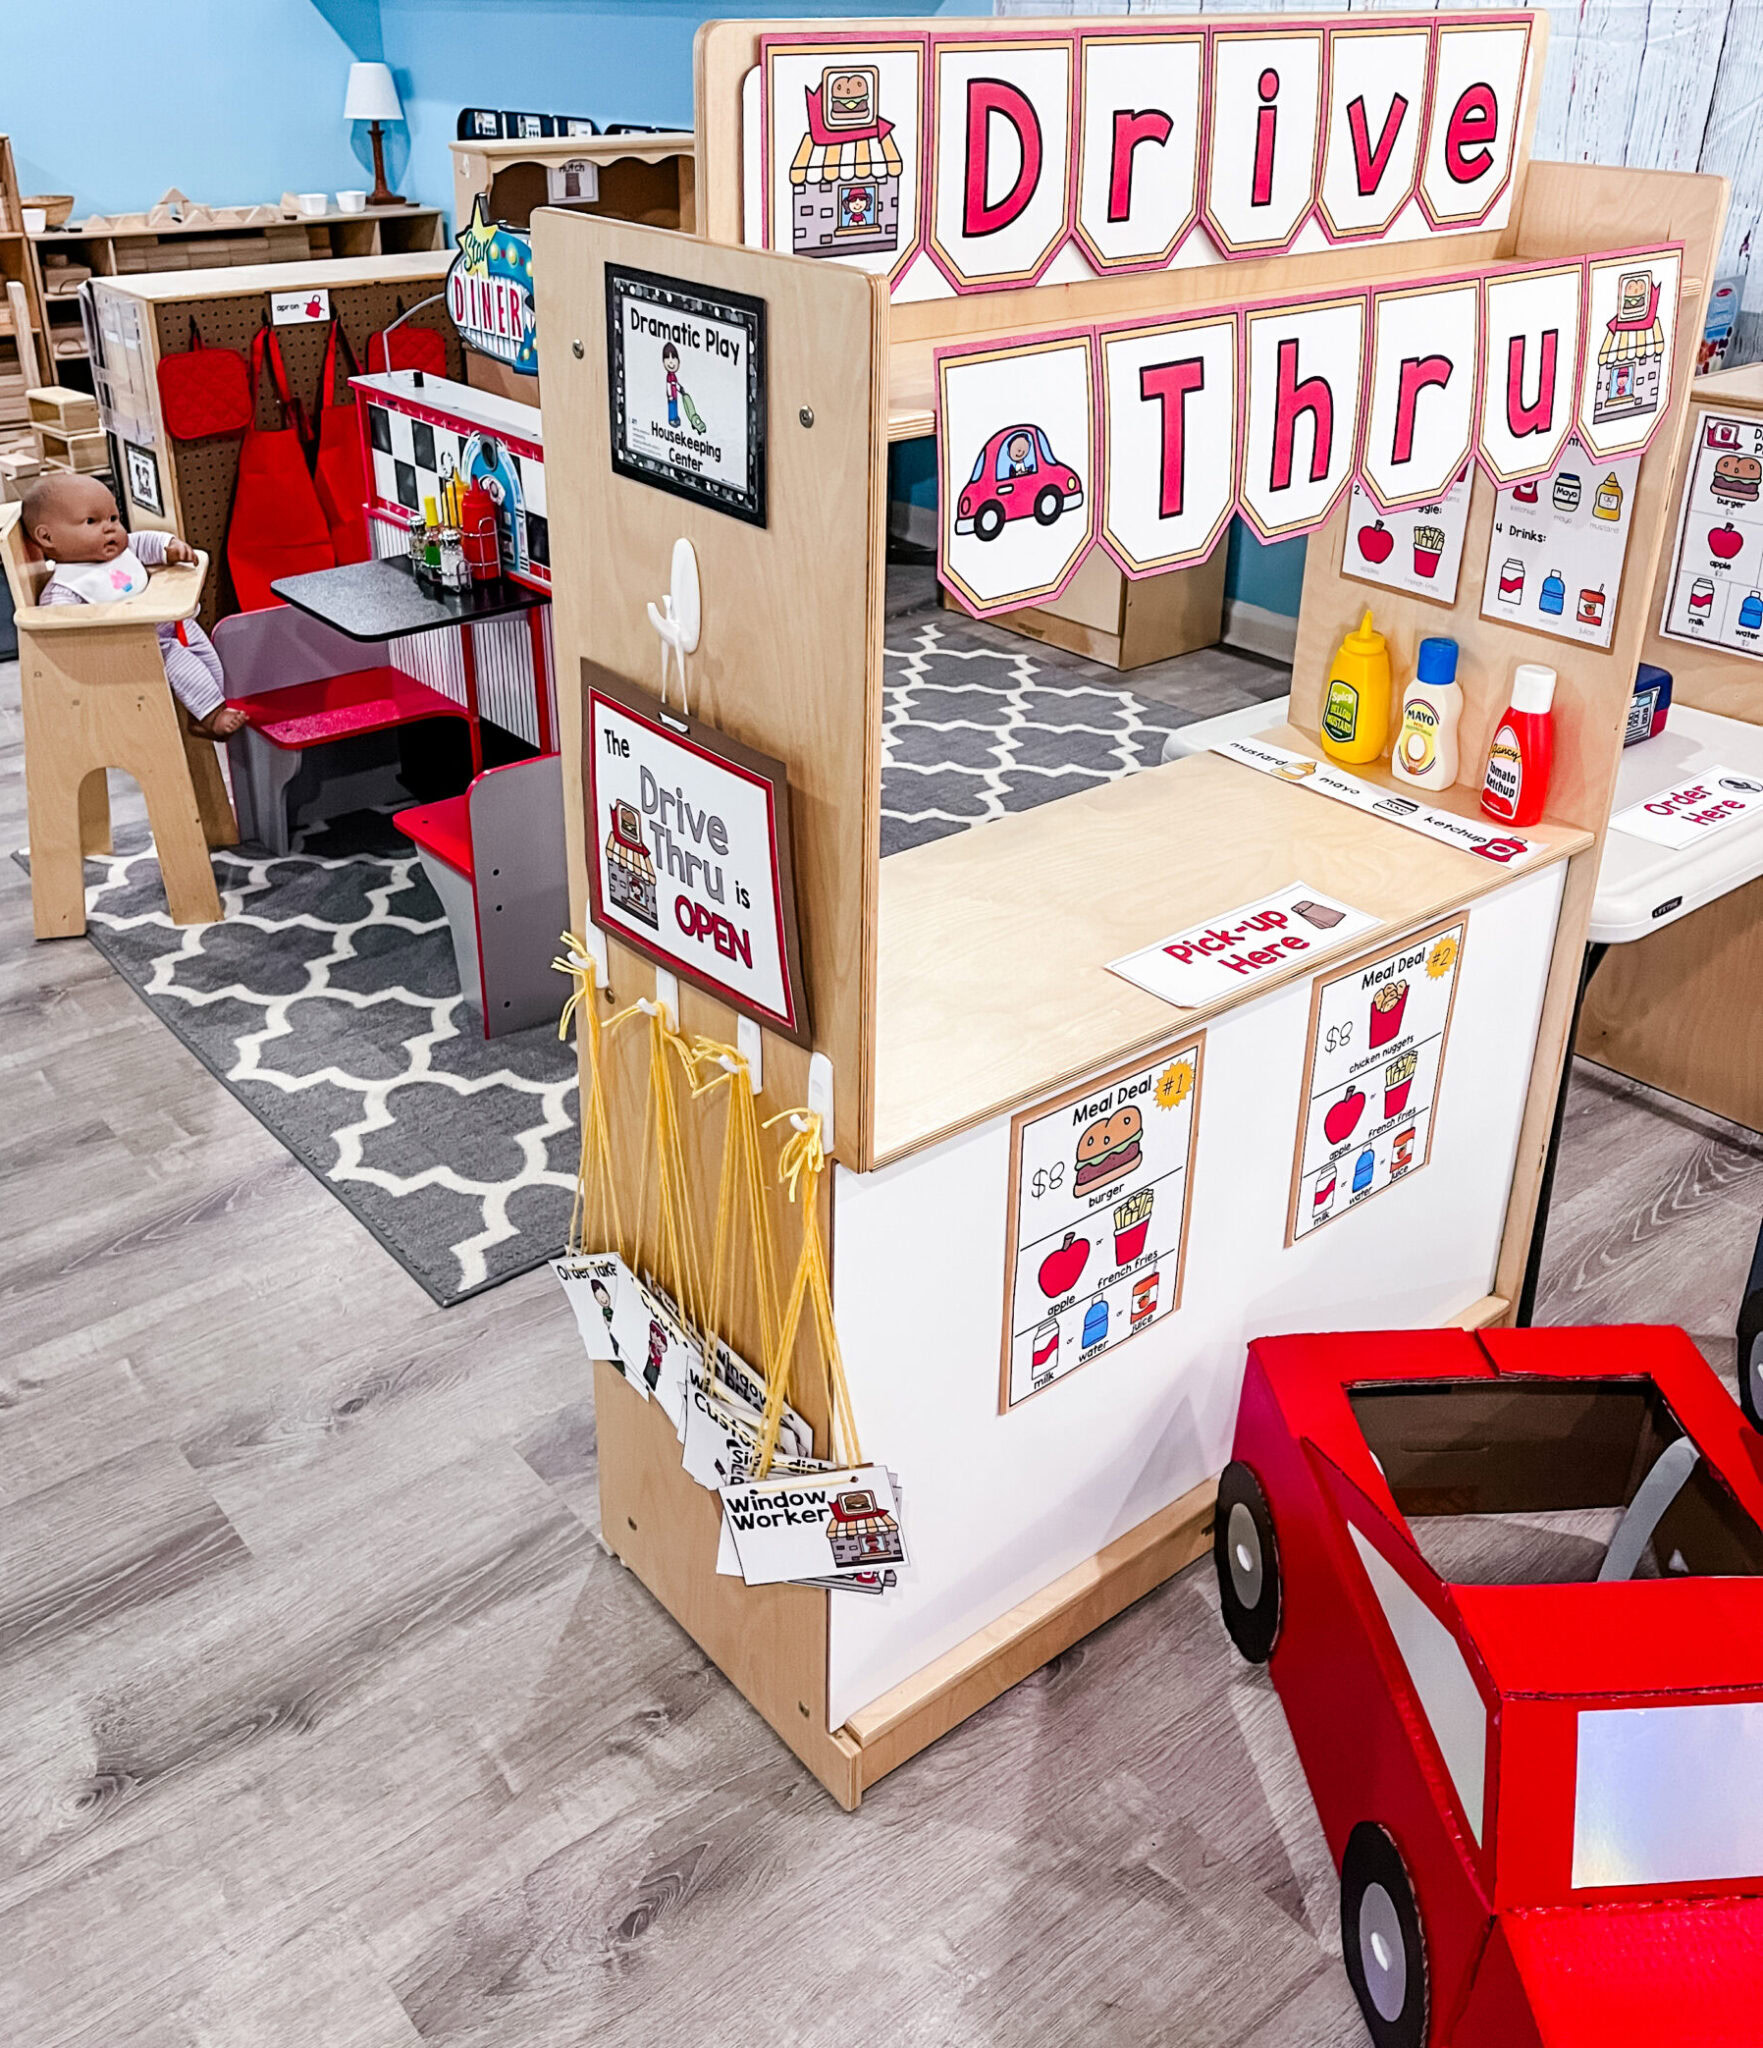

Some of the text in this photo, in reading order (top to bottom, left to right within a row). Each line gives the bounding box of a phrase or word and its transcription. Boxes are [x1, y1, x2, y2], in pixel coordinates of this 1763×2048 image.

[961, 66, 1499, 239] Drive
[463, 230, 490, 272] Star
[276, 302, 300, 313] apron
[454, 275, 522, 339] DINER
[630, 307, 740, 366] Dramatic Play
[1138, 327, 1560, 521] Thru
[651, 420, 721, 464] Housekeeping
[668, 446, 703, 472] Center
[1716, 496, 1746, 509] burger
[1494, 522, 1547, 543] 4 Drinks:
[1709, 560, 1731, 571] apple
[1735, 629, 1760, 640] water
[1406, 709, 1435, 727] MAYO
[603, 728, 630, 758] The
[1229, 740, 1287, 767] mustard
[1317, 775, 1361, 796] mayo
[639, 764, 729, 856] Drive
[1644, 785, 1712, 816] Order
[1681, 799, 1746, 826] Here
[1423, 815, 1487, 845] ketchup
[648, 820, 751, 910] Thru is
[674, 894, 753, 970] OPEN
[1161, 909, 1289, 965] Pick-up
[1217, 936, 1311, 975] Here
[1361, 946, 1426, 991] Meal Deal
[1431, 948, 1451, 967] #2
[1324, 1020, 1353, 1055] $8
[1349, 1035, 1414, 1075] chicken nuggets
[1162, 1073, 1184, 1096] #1
[1072, 1075, 1152, 1127] Meal Deal
[1367, 1106, 1417, 1138] french fries
[1328, 1142, 1352, 1162] apple
[1031, 1161, 1065, 1201] $8
[1389, 1163, 1409, 1184] juice
[1088, 1183, 1125, 1208] burger
[1348, 1186, 1373, 1205] water
[1313, 1210, 1330, 1226] milk
[1097, 1249, 1159, 1289] french fries
[1047, 1294, 1076, 1317] apple
[1130, 1313, 1153, 1336] juice
[1078, 1339, 1109, 1363] water
[1033, 1371, 1054, 1390] milk
[726, 1490, 827, 1516] Window
[731, 1507, 830, 1531] Worker
